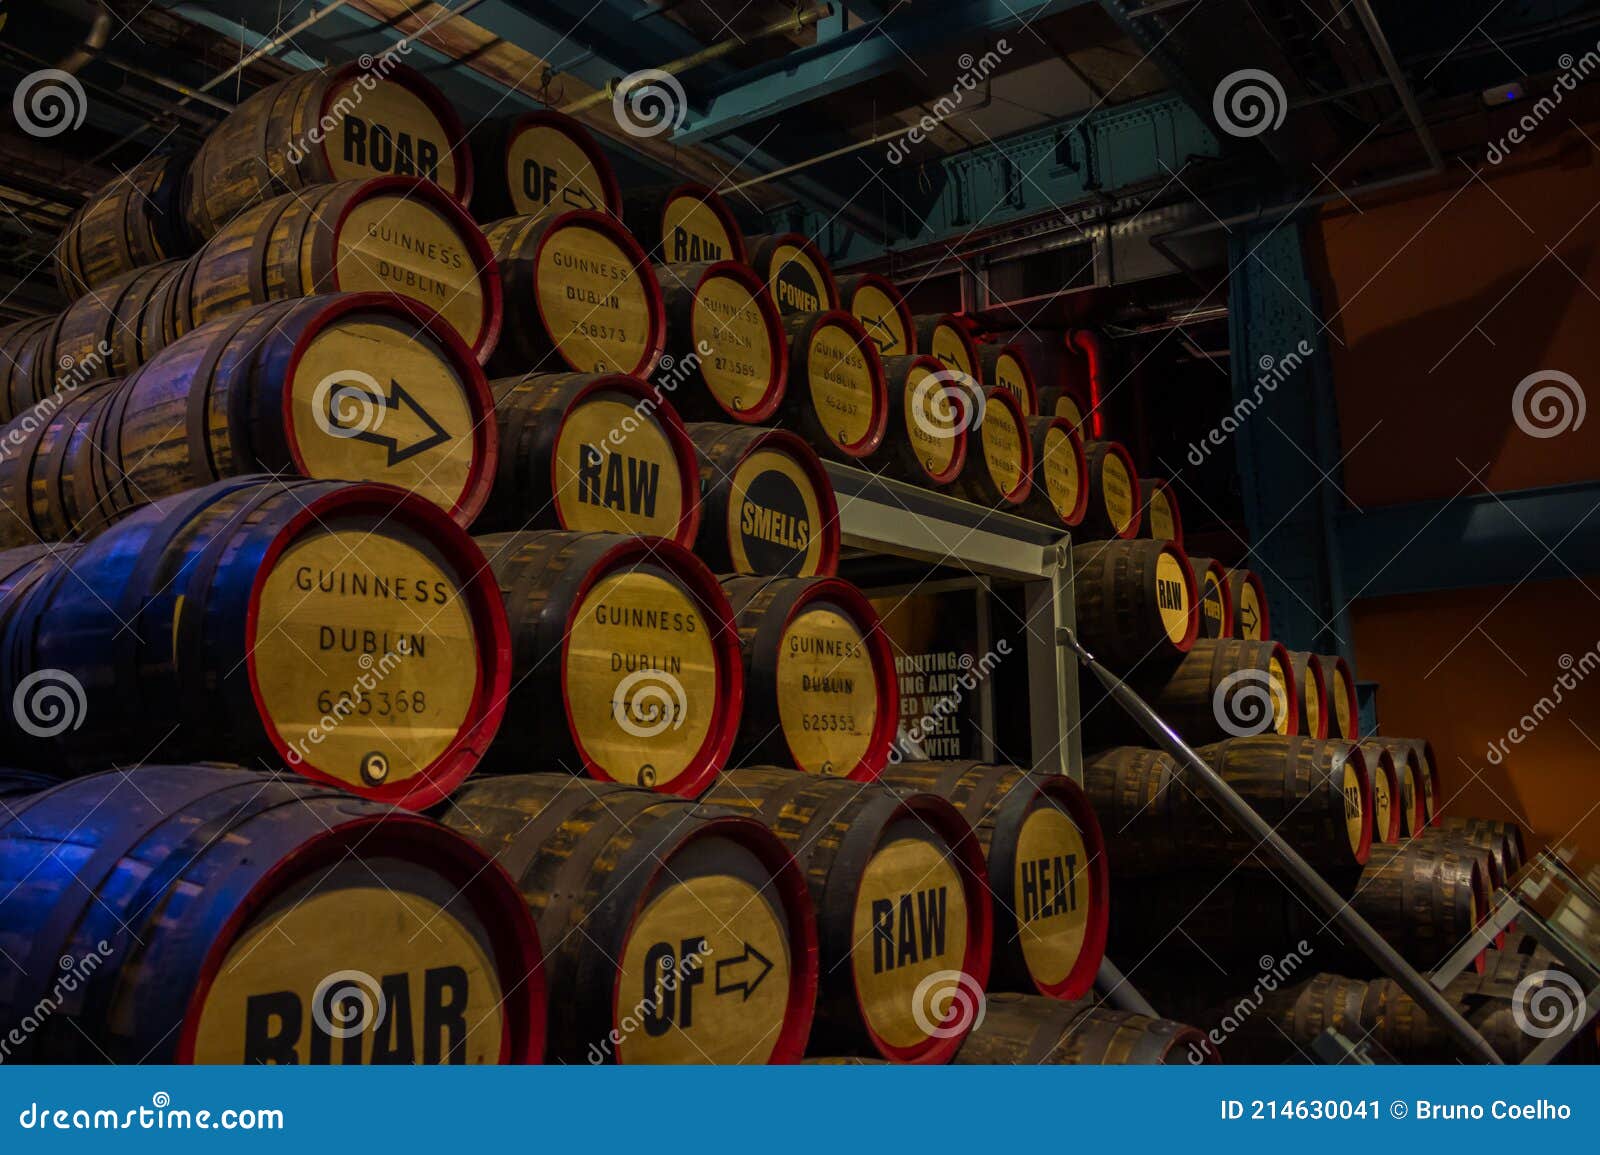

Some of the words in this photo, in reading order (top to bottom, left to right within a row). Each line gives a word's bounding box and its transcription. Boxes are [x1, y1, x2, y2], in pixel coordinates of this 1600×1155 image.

[344, 114, 438, 184] ROAR
[523, 158, 557, 207] OF
[368, 222, 462, 269] GUINNESS
[379, 262, 447, 298] DUBLIN
[553, 252, 629, 282] GUINNESS
[567, 286, 619, 310] DUBLIN
[779, 279, 819, 313] POWER
[578, 443, 659, 518] RAW
[741, 501, 809, 552] SMELLS
[296, 566, 449, 604] GUINNESS
[1158, 579, 1182, 611] RAW
[595, 604, 697, 632] GUINNESS
[319, 626, 426, 658] DUBLIN
[790, 635, 862, 658] GUINNESS
[611, 652, 682, 673] DUBLIN
[803, 674, 853, 694] DUBLIN
[929, 672, 959, 694] AND
[1022, 853, 1077, 921] HEAT
[872, 887, 947, 974] RAW
[643, 936, 705, 1038] OF
[244, 965, 469, 1065] ROAR
